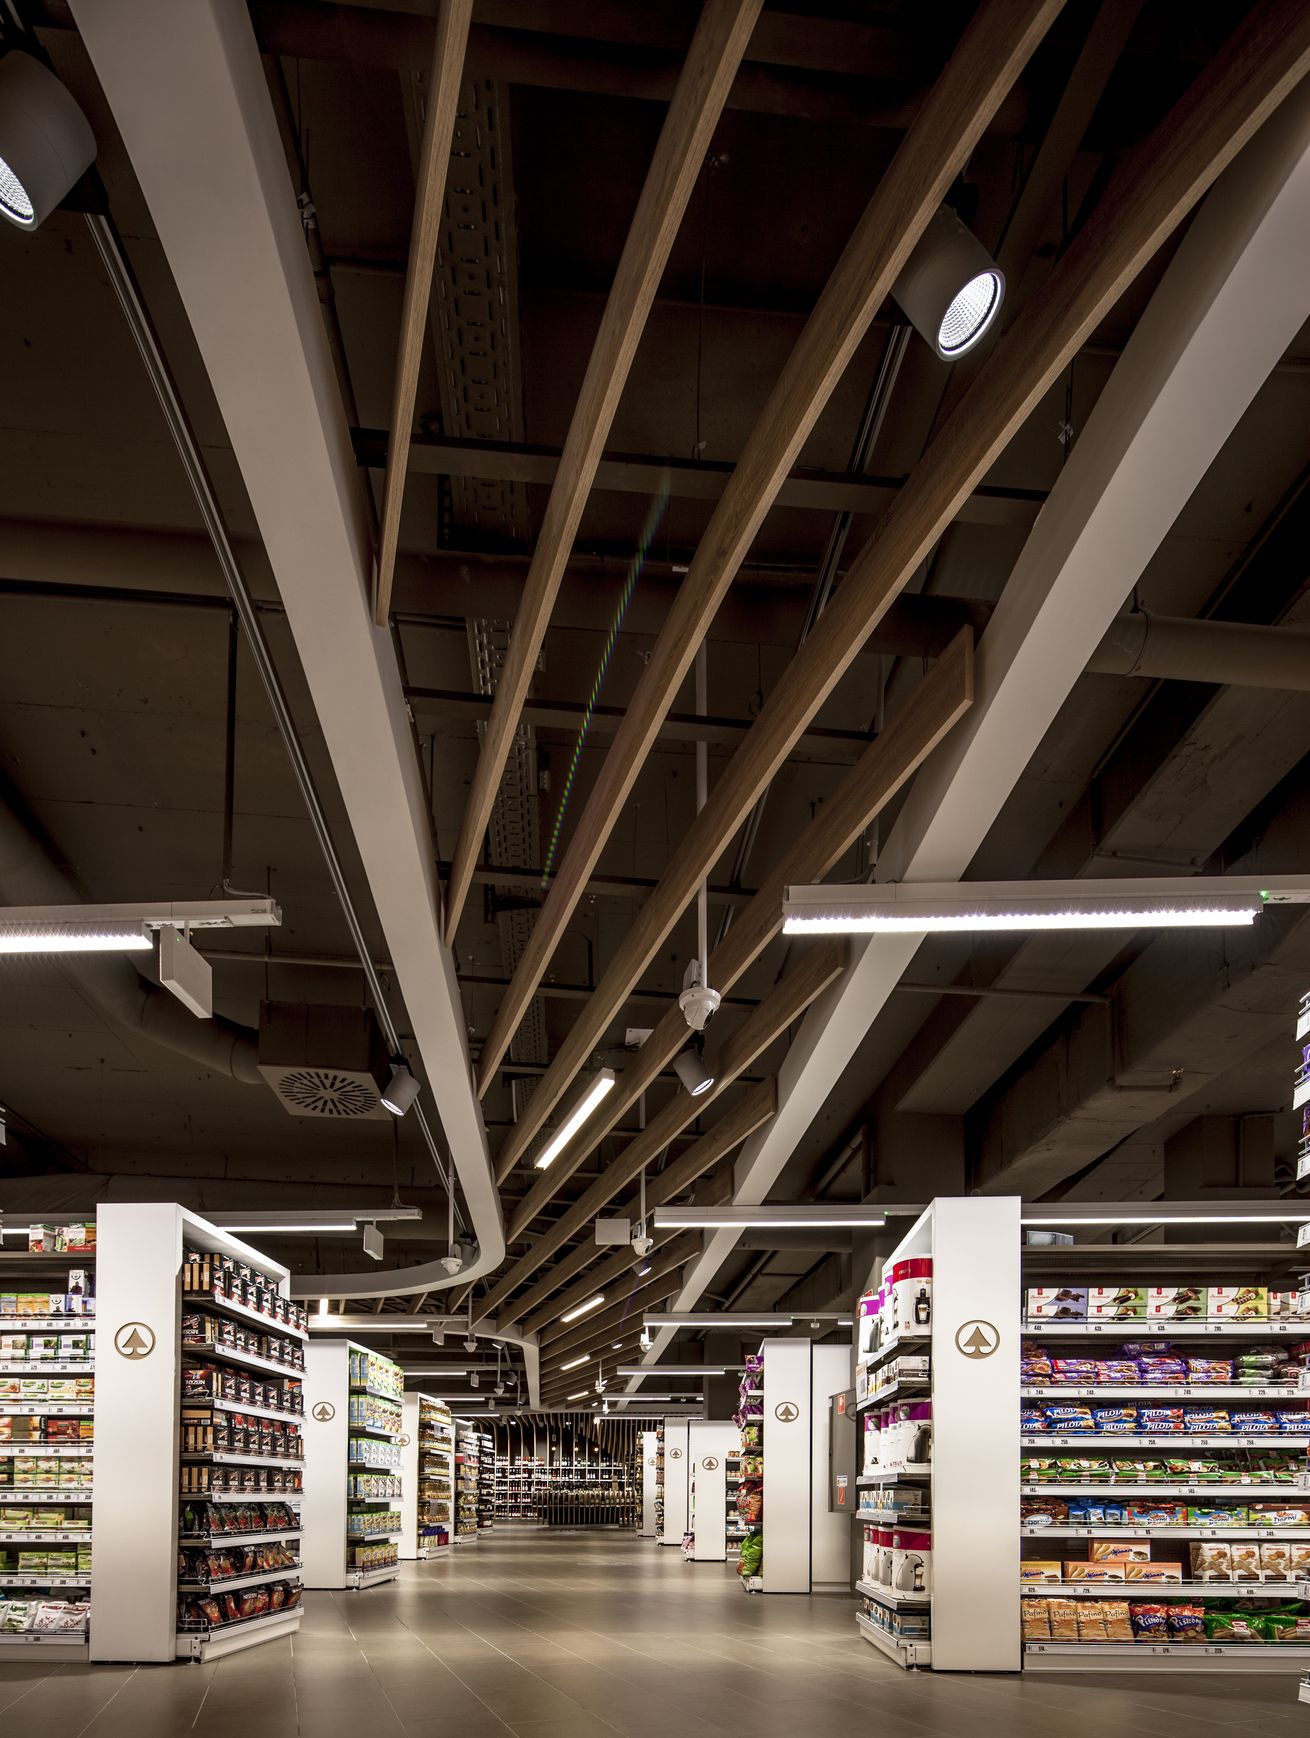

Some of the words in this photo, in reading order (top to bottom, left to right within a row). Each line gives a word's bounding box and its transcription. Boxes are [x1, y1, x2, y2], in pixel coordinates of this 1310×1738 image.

[1024, 1610, 1046, 1618] Pafino
[1053, 1610, 1076, 1618] Pafino
[1077, 1611, 1101, 1619] Pafino
[1104, 1610, 1128, 1618] Pafino
